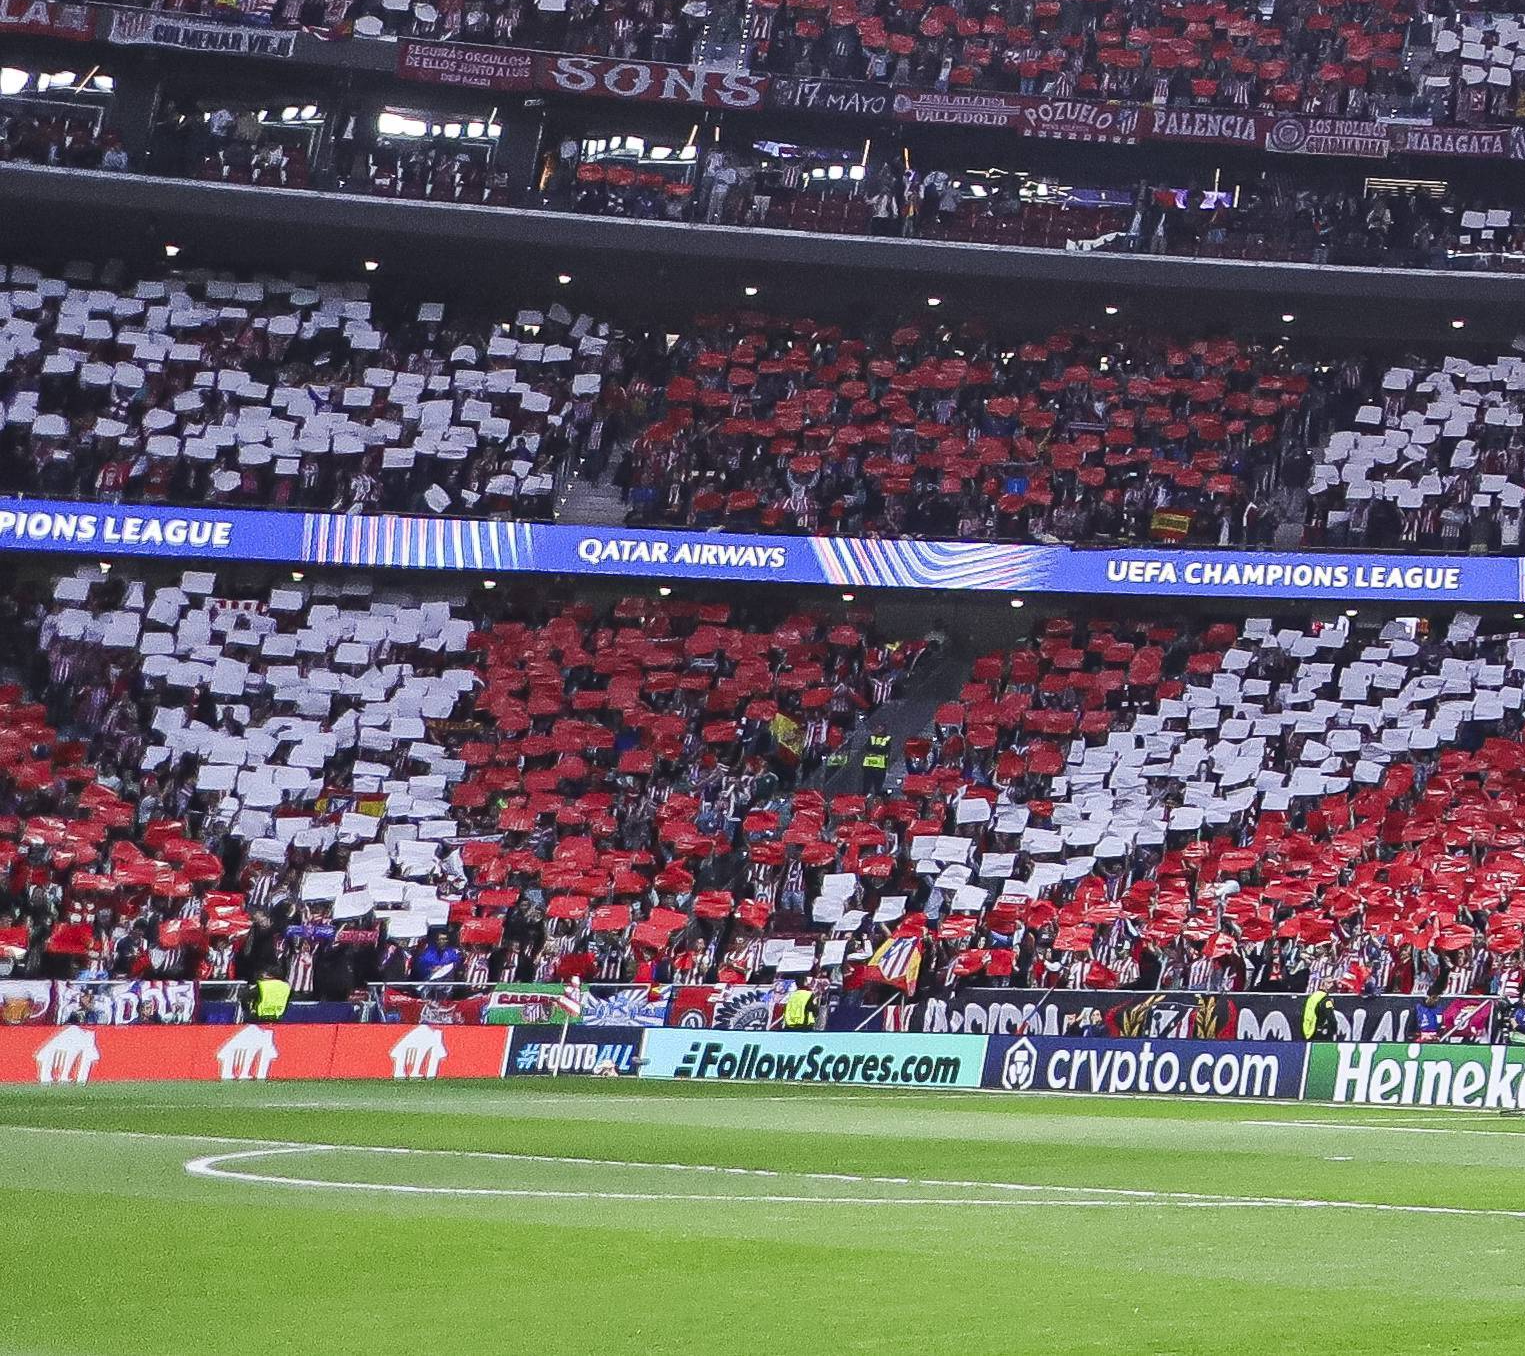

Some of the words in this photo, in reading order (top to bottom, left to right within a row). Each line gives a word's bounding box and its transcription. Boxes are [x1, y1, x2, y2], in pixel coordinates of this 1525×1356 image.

[405, 55, 421, 68] DE
[422, 57, 456, 71] ELLOS
[458, 61, 495, 77] JUNTO
[496, 65, 505, 77] A
[505, 66, 530, 79] LUIS
[465, 51, 532, 67] ORGULLOSA
[550, 56, 768, 108] SONS
[826, 92, 887, 115] MAYO
[915, 110, 1008, 126] VALLADOLID
[1024, 101, 1113, 130] POZUELO
[1153, 111, 1257, 141] PALENCIA
[1308, 119, 1332, 134] LOS
[1406, 132, 1504, 154] MARAGATA
[103, 516, 234, 549] LEAGUE
[576, 537, 667, 567] QATAR
[674, 540, 787, 570] AIRWAYS
[1106, 559, 1181, 584] UEFA
[1184, 561, 1350, 588] CHAMPIONS
[1354, 564, 1461, 590] LEAGUE
[515, 1043, 636, 1073] #FOOTBALL
[699, 1043, 961, 1084] FollowScores.com
[1046, 1042, 1280, 1097] crypto.com
